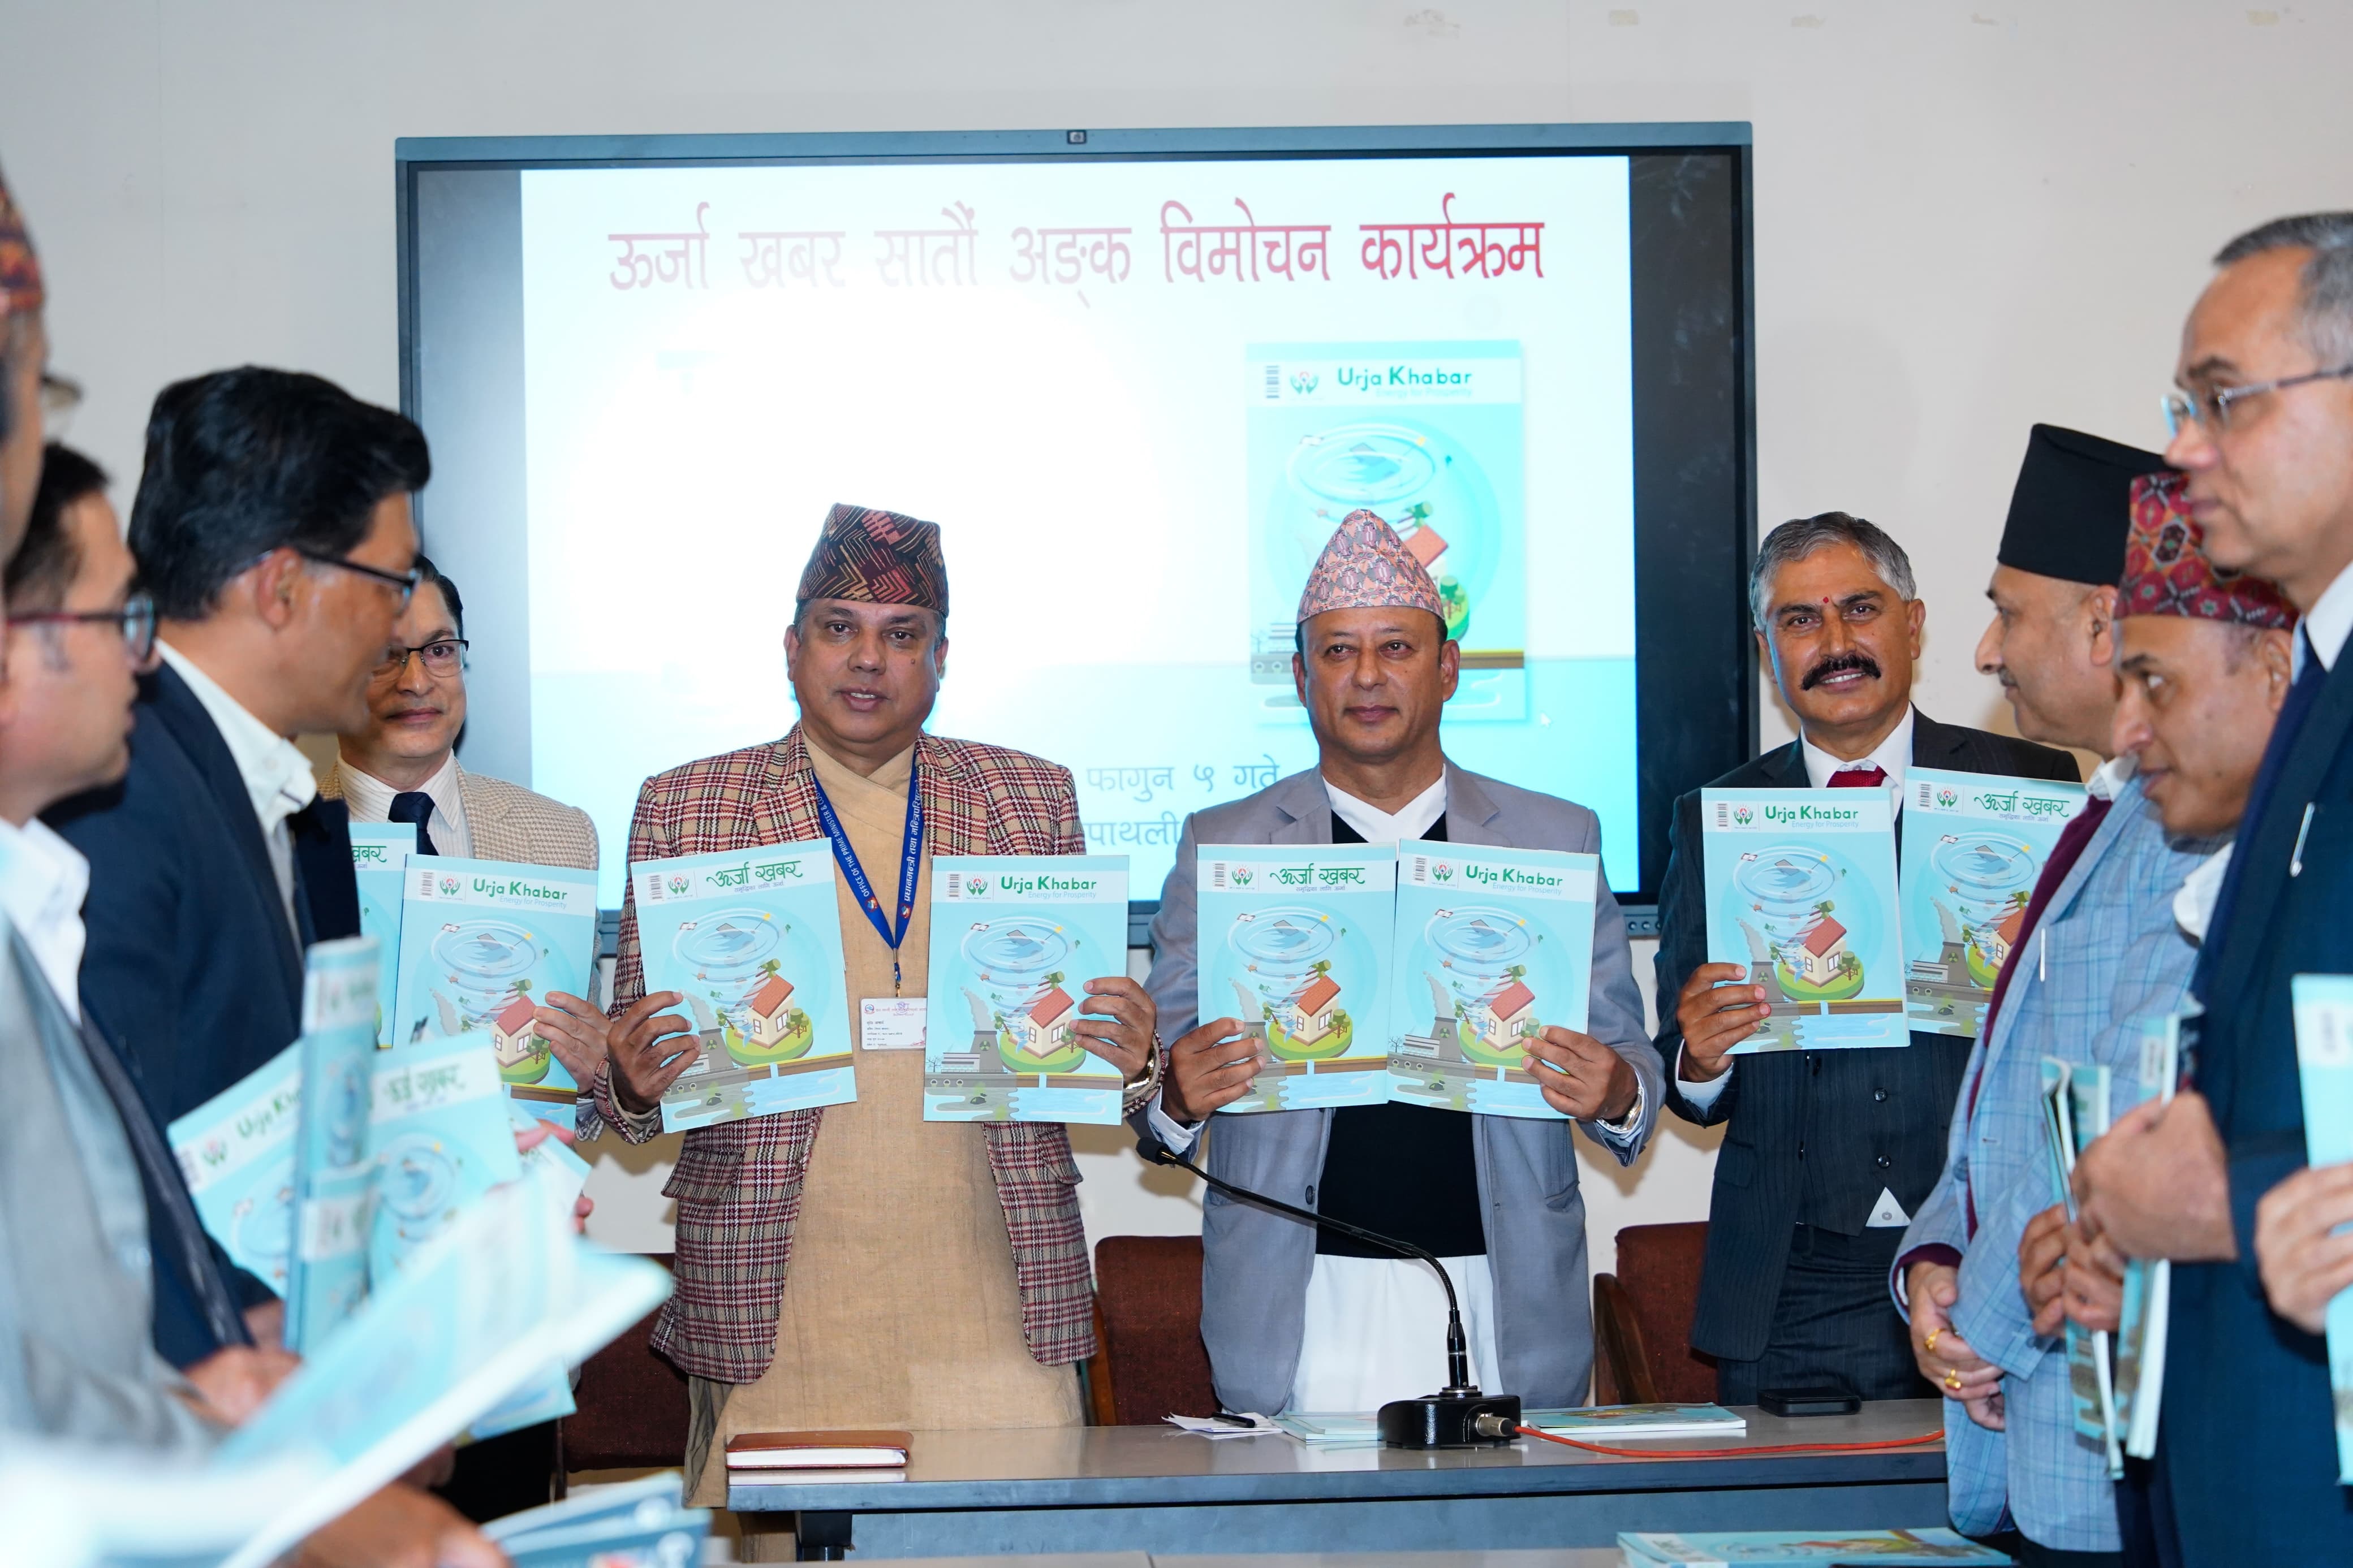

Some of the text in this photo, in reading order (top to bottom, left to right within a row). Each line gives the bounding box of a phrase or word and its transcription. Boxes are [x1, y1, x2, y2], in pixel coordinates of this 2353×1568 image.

[608, 201, 710, 290] ऊर्जा
[738, 231, 846, 288] खबर
[1009, 226, 1132, 309] अङ्क
[1160, 197, 1331, 283] विमोचन
[1359, 192, 1545, 279] कार्यक्रम
[1338, 366, 1472, 391] Urja Khabar
[1086, 767, 1175, 802] फागुन
[1232, 753, 1280, 789] गते
[1765, 805, 1859, 824] Urja Khabar
[1973, 790, 2070, 818] ऊर्जा खबर
[824, 811, 841, 837] MINISTER
[1083, 810, 1180, 845] पाथली
[1826, 820, 1859, 829] Prosperity
[836, 838, 850, 856] PRIME
[845, 855, 856, 868] THE
[851, 867, 859, 877] OF
[706, 860, 803, 888] ऊर्जा खबर
[1269, 862, 1366, 885] ऊर्जा खबर
[1466, 865, 1563, 886] Urja Khabar
[473, 878, 568, 900] Urja Khabar
[855, 875, 870, 897] OFFICE
[1001, 875, 1097, 895] Urja Khabar
[1028, 891, 1050, 900] Energy
[1063, 891, 1097, 900] Prosperity
[1492, 882, 1562, 896] Energy for Prosperity
[499, 896, 522, 905] Energy
[534, 899, 567, 910] Prosperity
